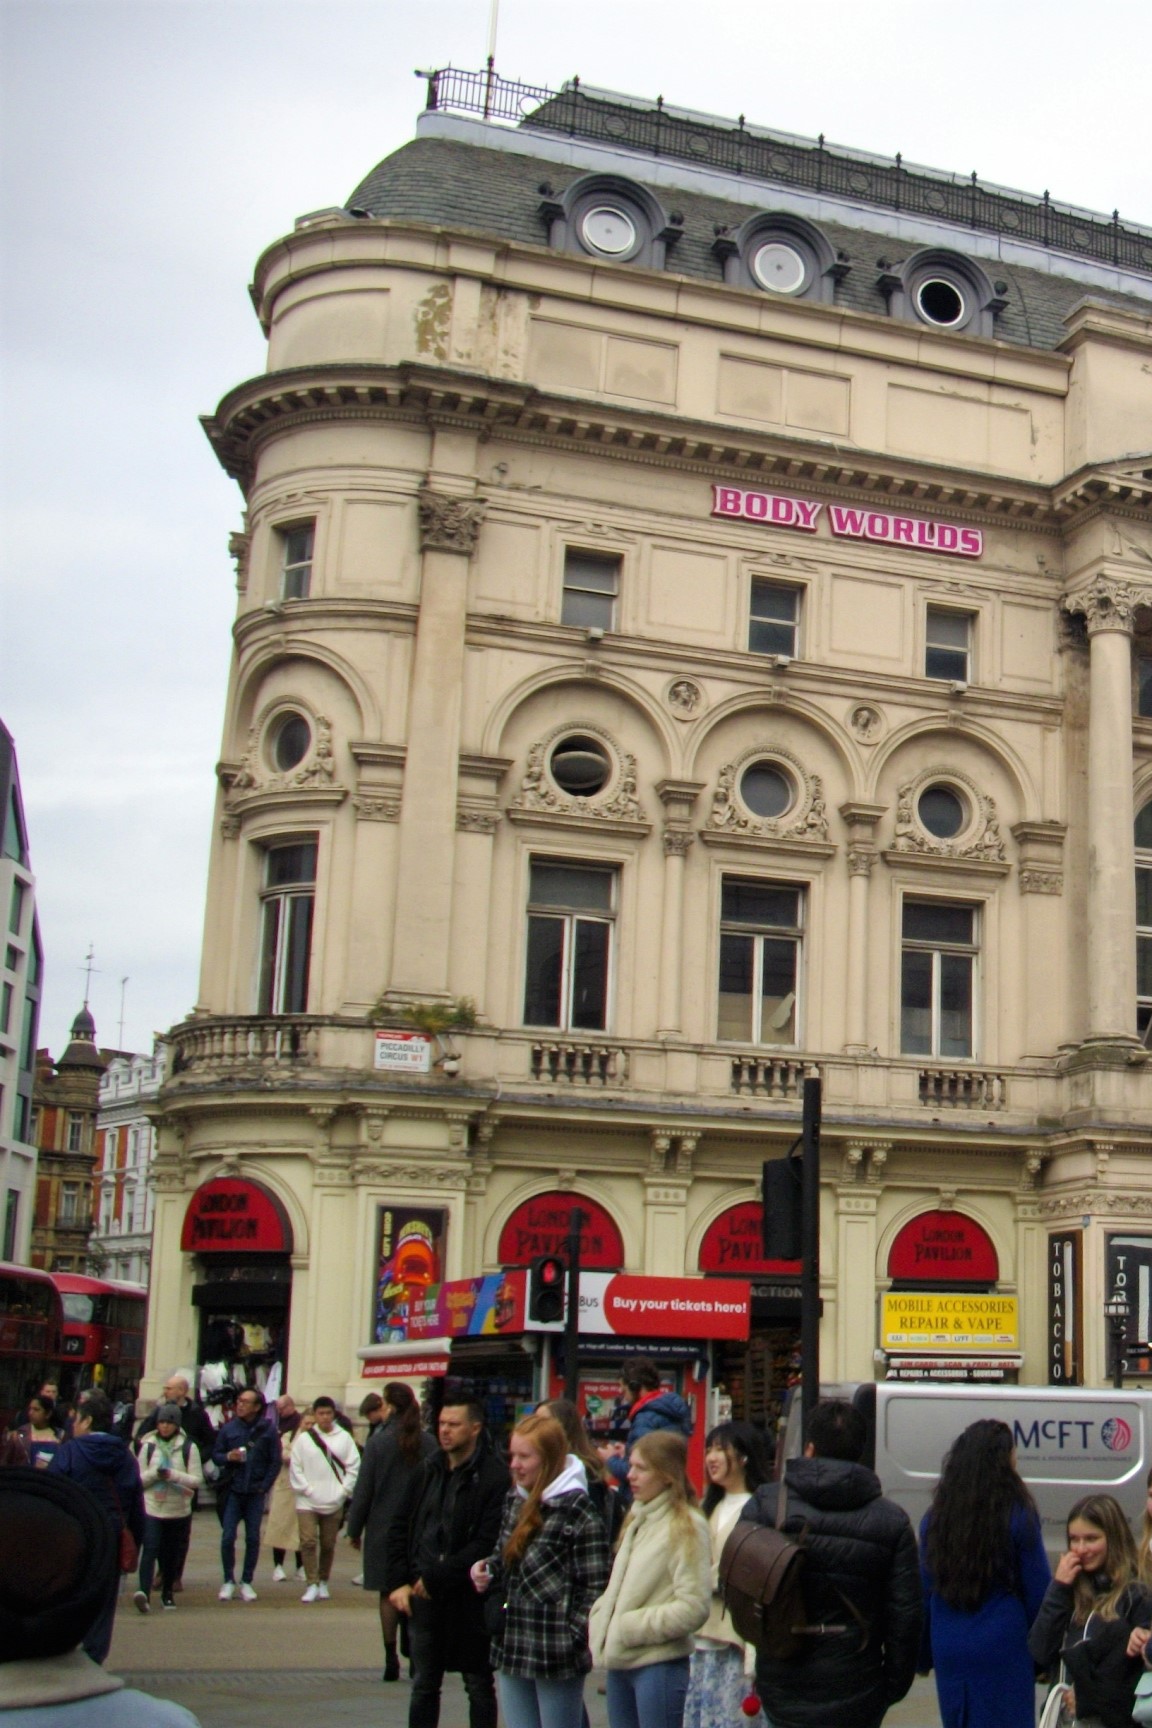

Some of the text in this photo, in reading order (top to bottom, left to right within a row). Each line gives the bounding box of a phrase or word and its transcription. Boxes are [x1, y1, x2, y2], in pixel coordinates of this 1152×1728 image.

[715, 486, 983, 556] BODY WORLDS
[380, 1042, 425, 1053] PICCADILLY
[380, 1051, 408, 1061] CIRCUS
[527, 1202, 591, 1228] LONDN
[613, 1297, 747, 1313] Buy your tickets here!
[887, 1299, 1014, 1313] MOBILE ACCESSORIES
[1053, 1242, 1062, 1378] TOBACCO
[900, 1316, 1003, 1330] REPAIR & VAPE
